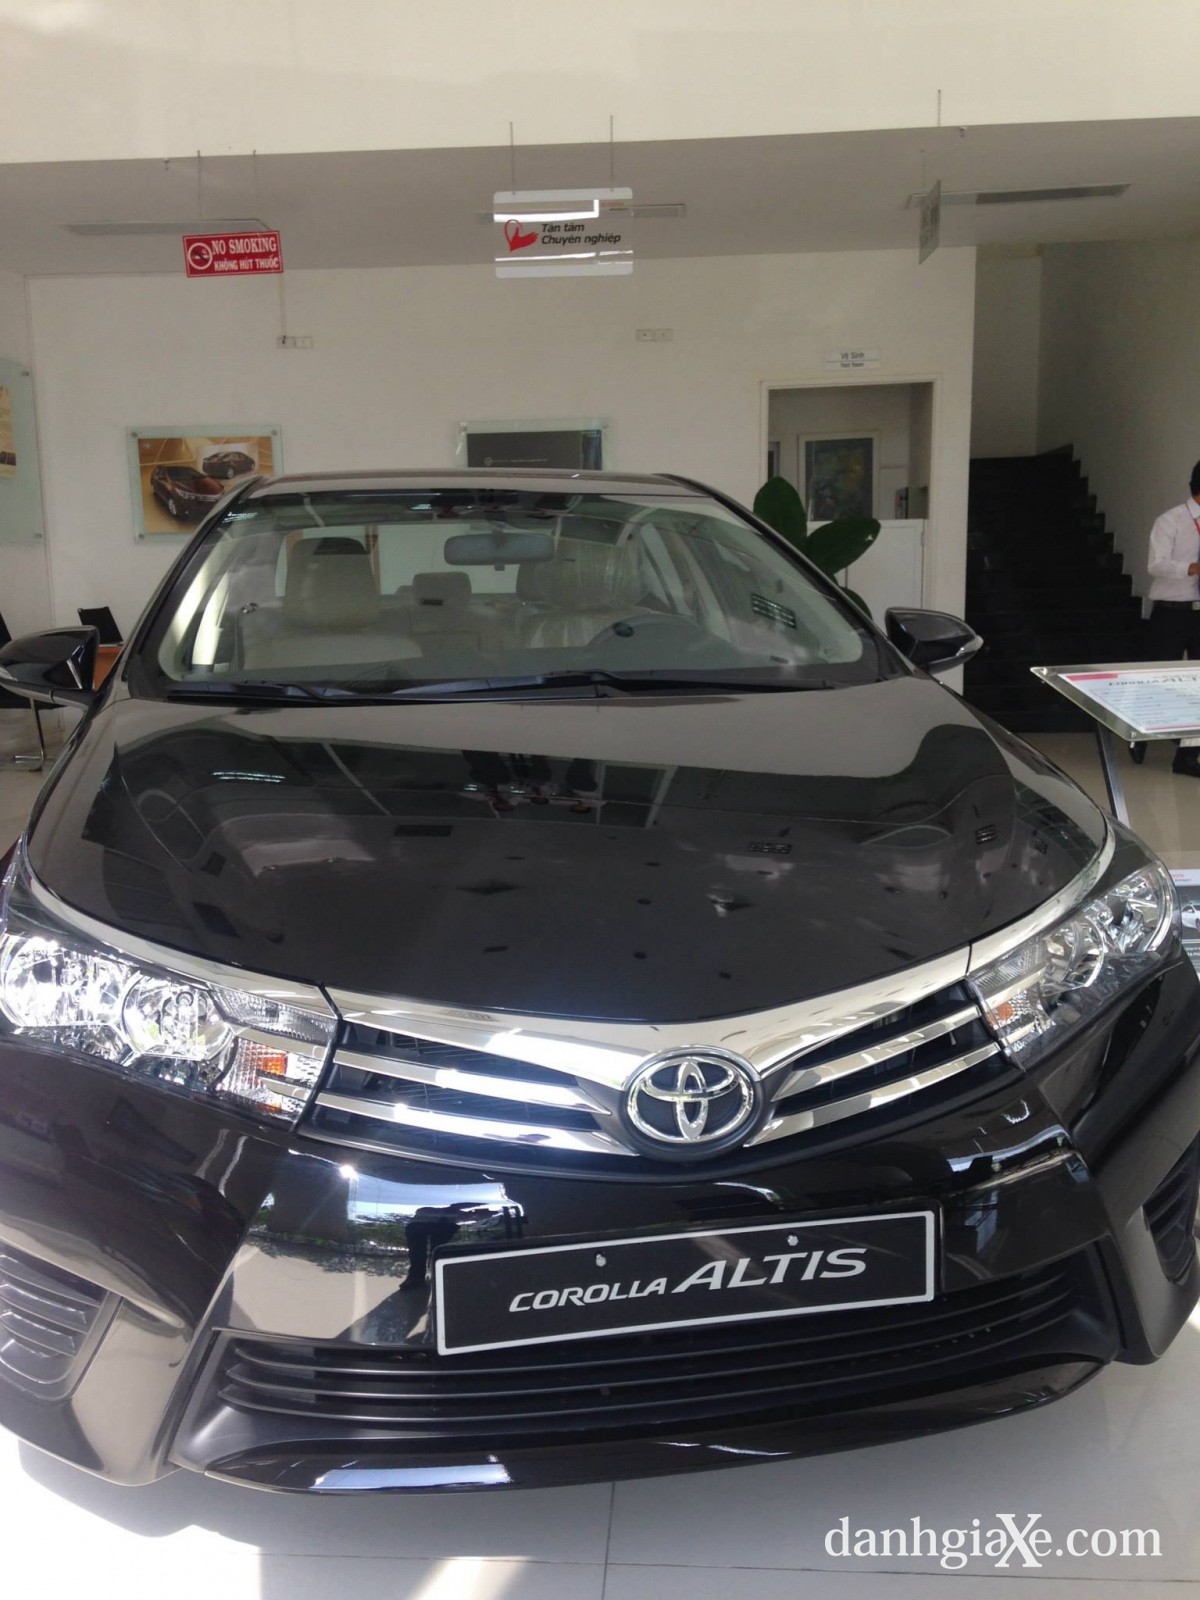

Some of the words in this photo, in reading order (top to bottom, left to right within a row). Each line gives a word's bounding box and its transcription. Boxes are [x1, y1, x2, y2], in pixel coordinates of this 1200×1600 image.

[211, 240, 226, 255] NO
[228, 237, 277, 255] SMOKING
[541, 234, 581, 246] Chuyên
[213, 258, 238, 272] KHÔNG
[508, 1276, 669, 1313] COROLLA
[671, 1248, 868, 1294] ALTIS
